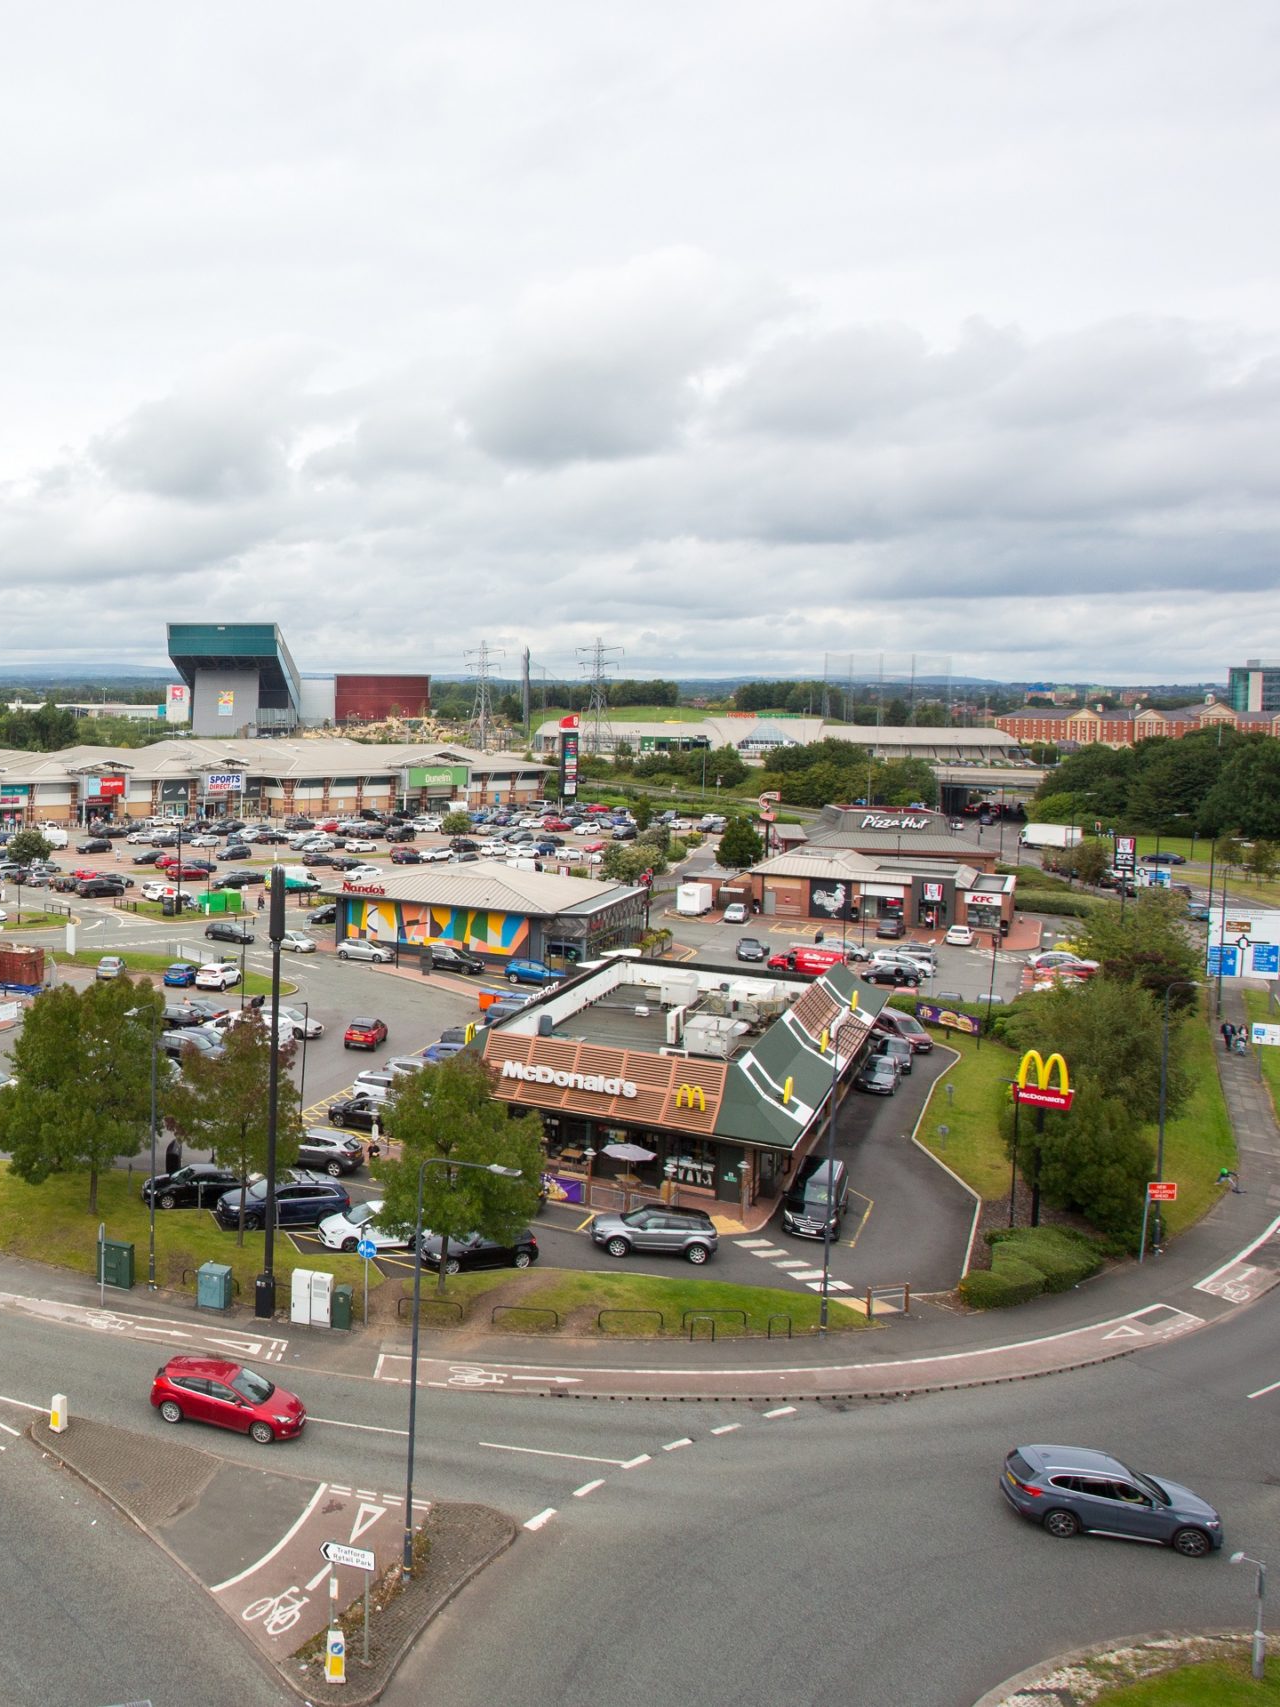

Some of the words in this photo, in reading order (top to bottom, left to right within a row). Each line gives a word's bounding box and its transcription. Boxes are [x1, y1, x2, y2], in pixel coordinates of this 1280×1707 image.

[210, 775, 241, 783] SPORTS
[861, 815, 900, 829] Pizza
[900, 817, 930, 829] Hut
[342, 881, 385, 895] Nando's
[972, 895, 993, 903] KFC
[502, 1060, 637, 1098] McDonald's
[1018, 1092, 1065, 1104] McDonald's
[337, 1547, 366, 1559] Trafford
[333, 1553, 353, 1563] Retail
[355, 1558, 371, 1567] Park
